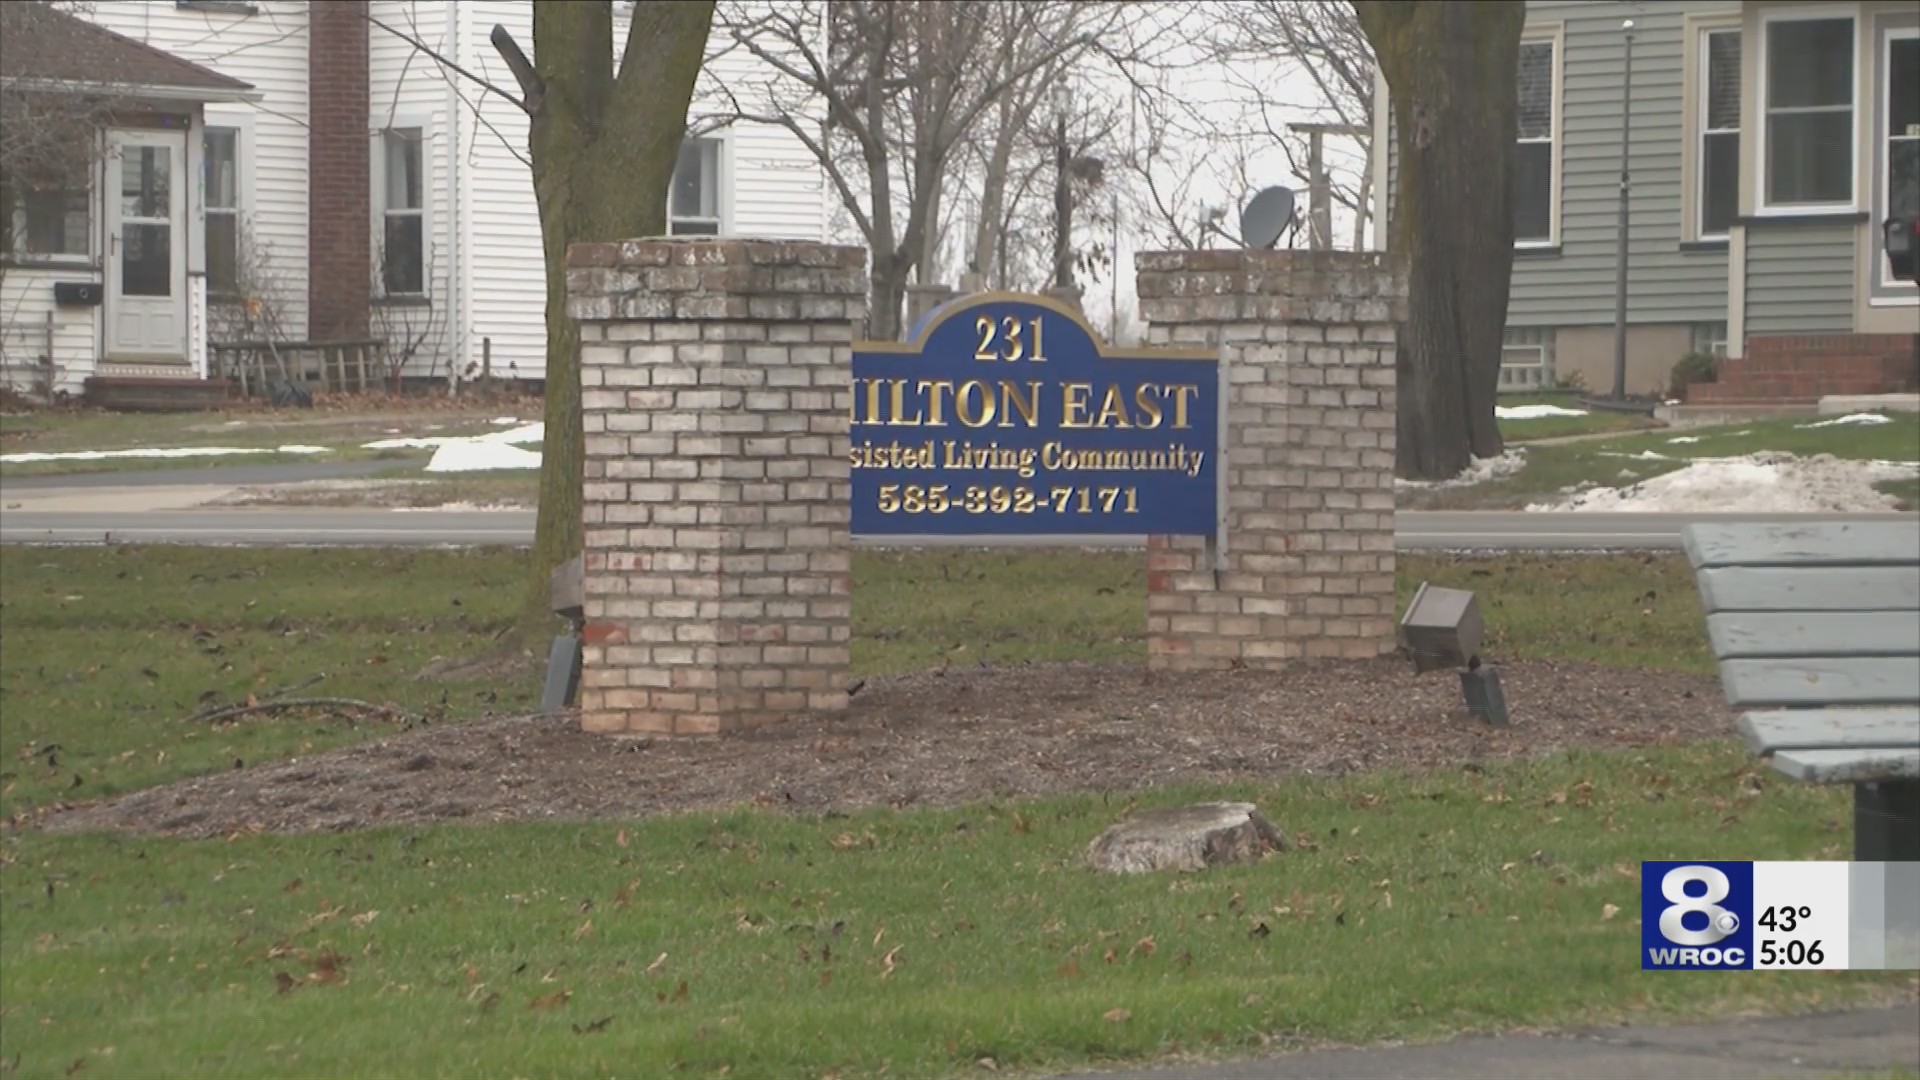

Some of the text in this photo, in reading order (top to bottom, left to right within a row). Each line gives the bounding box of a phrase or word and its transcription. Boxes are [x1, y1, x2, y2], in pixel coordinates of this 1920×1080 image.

[975, 315, 1048, 362] 231
[1059, 382, 1198, 429] EAST
[943, 440, 1038, 477] Living
[1042, 441, 1205, 477] Community
[878, 484, 1140, 514] 585-392-7171
